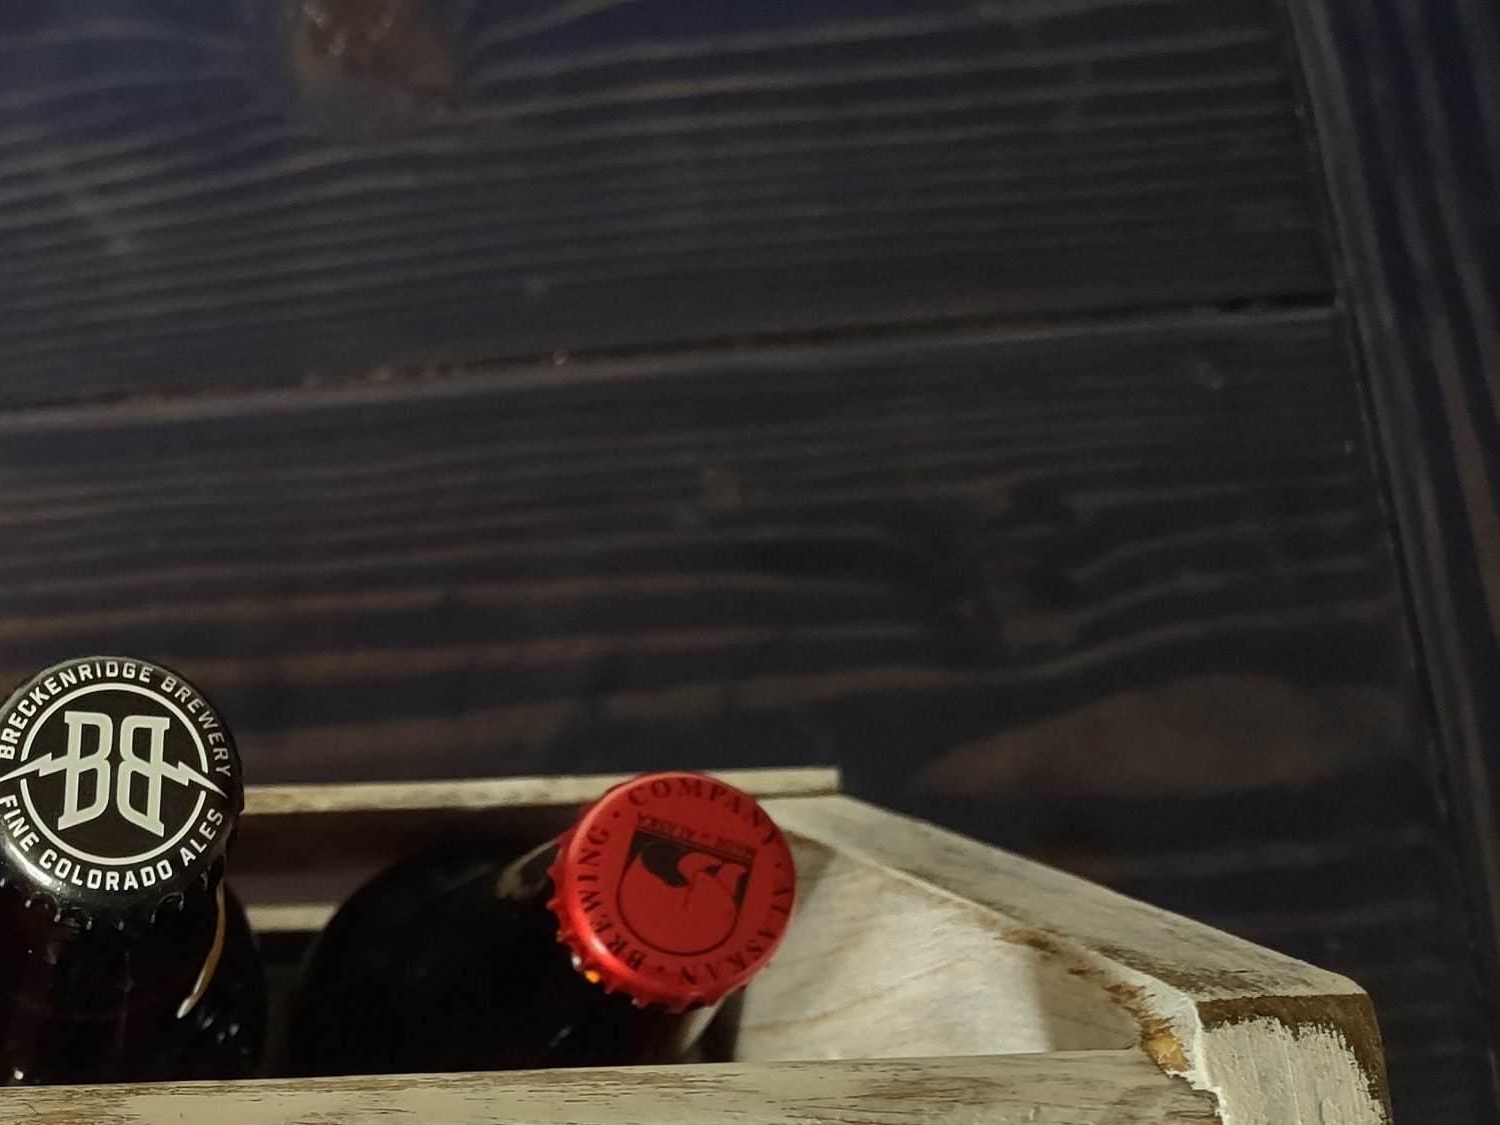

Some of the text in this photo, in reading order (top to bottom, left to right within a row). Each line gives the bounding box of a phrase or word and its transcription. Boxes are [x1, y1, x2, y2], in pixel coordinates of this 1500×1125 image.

[160, 675, 231, 777] BREWERY
[38, 849, 174, 891] COLORADO
[181, 808, 224, 867] ALES
[577, 826, 647, 970] BREWING
[629, 777, 779, 845] COMPANY
